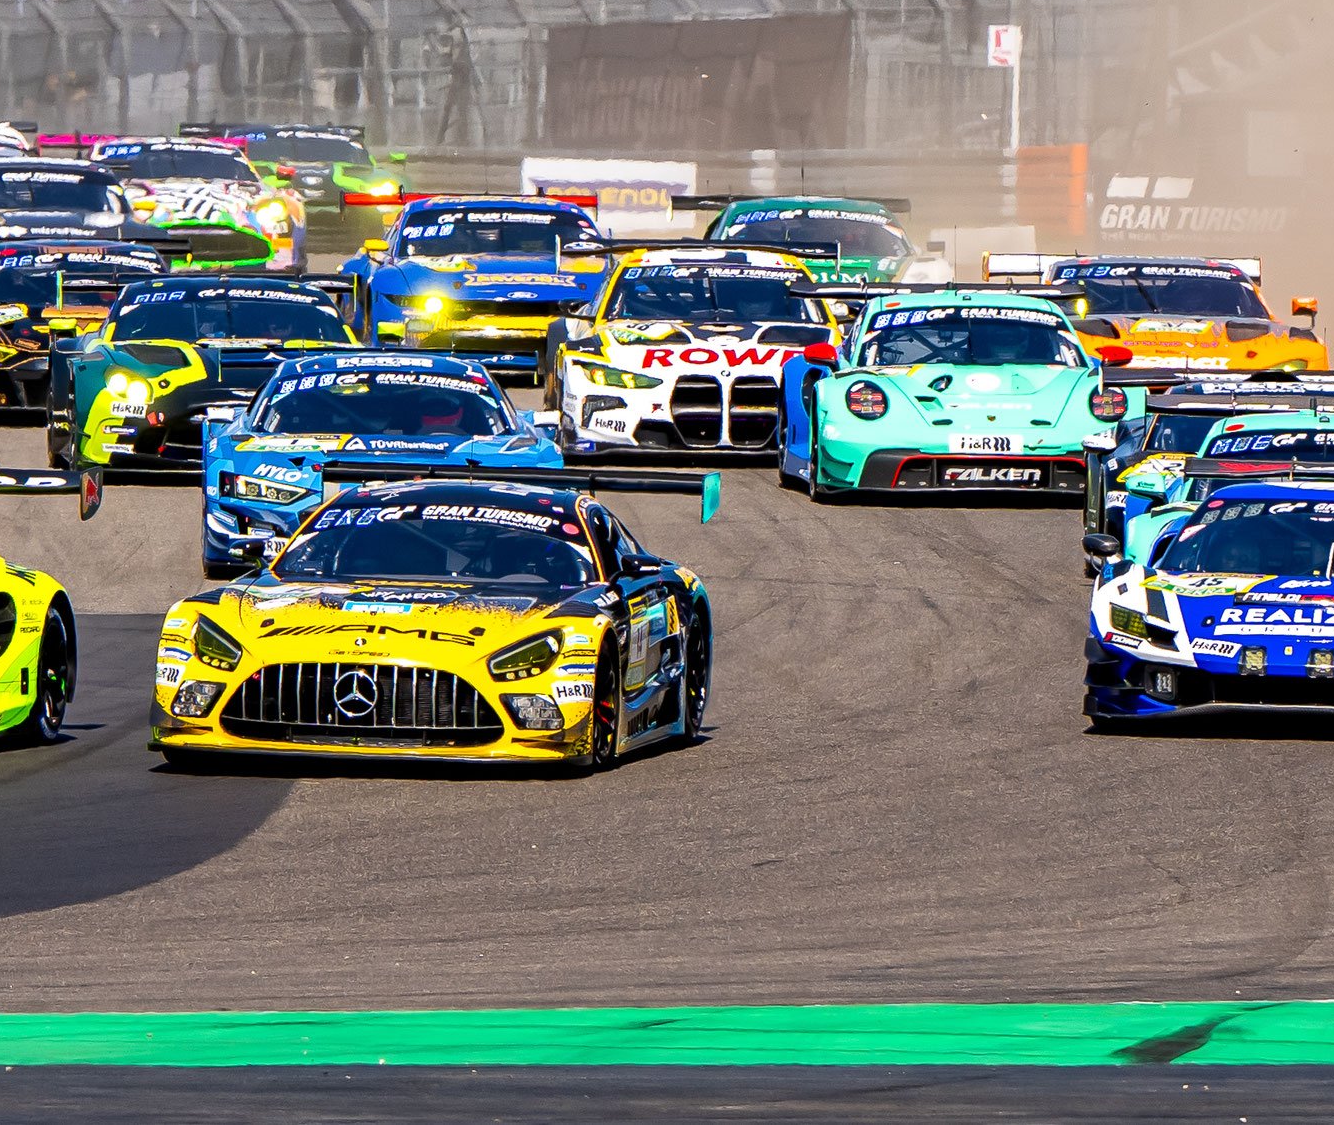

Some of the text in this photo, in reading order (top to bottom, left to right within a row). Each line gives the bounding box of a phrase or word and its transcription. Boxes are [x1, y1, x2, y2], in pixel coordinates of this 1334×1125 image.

[1101, 204, 1169, 229] GRAN
[253, 464, 303, 483] HYLO
[945, 468, 1041, 482] FALKEN
[422, 505, 475, 518] GRAN
[476, 507, 553, 527] TURISMO
[1190, 577, 1227, 588] 45
[331, 624, 475, 646] AMG
[556, 684, 582, 698] H&R
